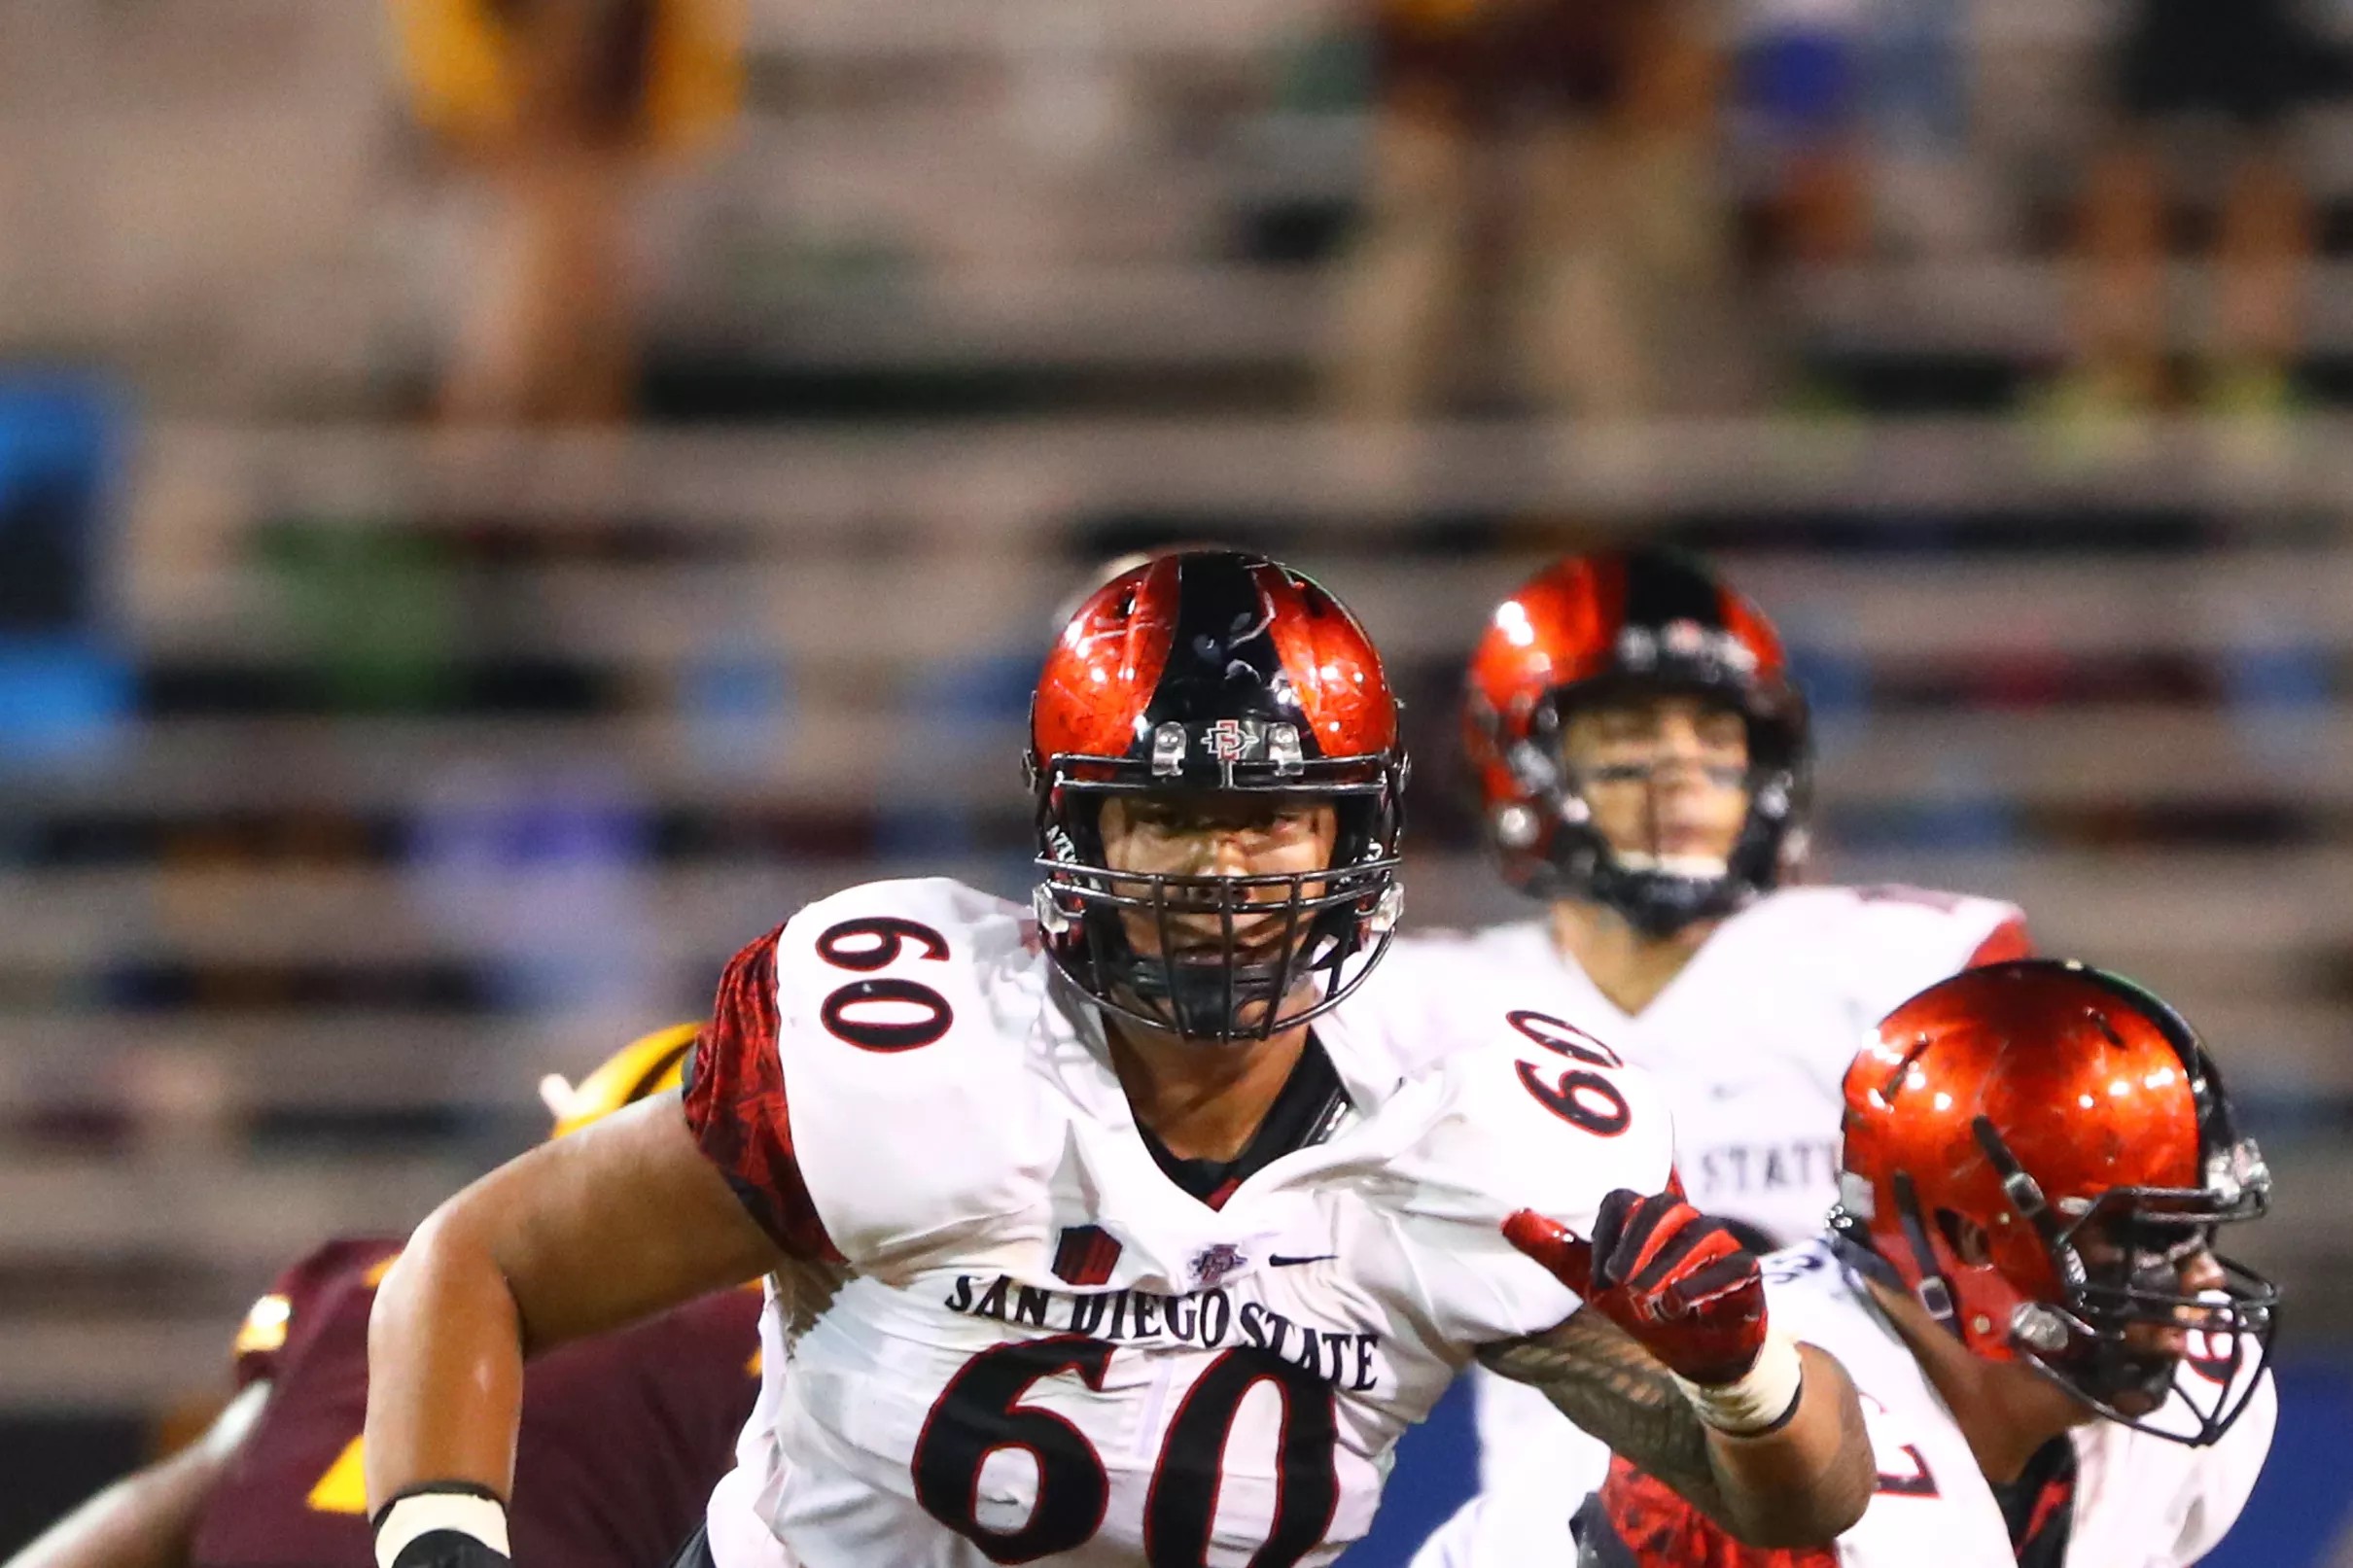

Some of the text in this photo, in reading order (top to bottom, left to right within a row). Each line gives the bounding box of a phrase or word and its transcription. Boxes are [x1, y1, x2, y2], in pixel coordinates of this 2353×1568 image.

[815, 916, 954, 1054] 60
[1505, 1009, 1633, 1139] 60
[944, 1274, 1379, 1391] SAN DIEGO STATE
[911, 1333, 1340, 1568] 60
